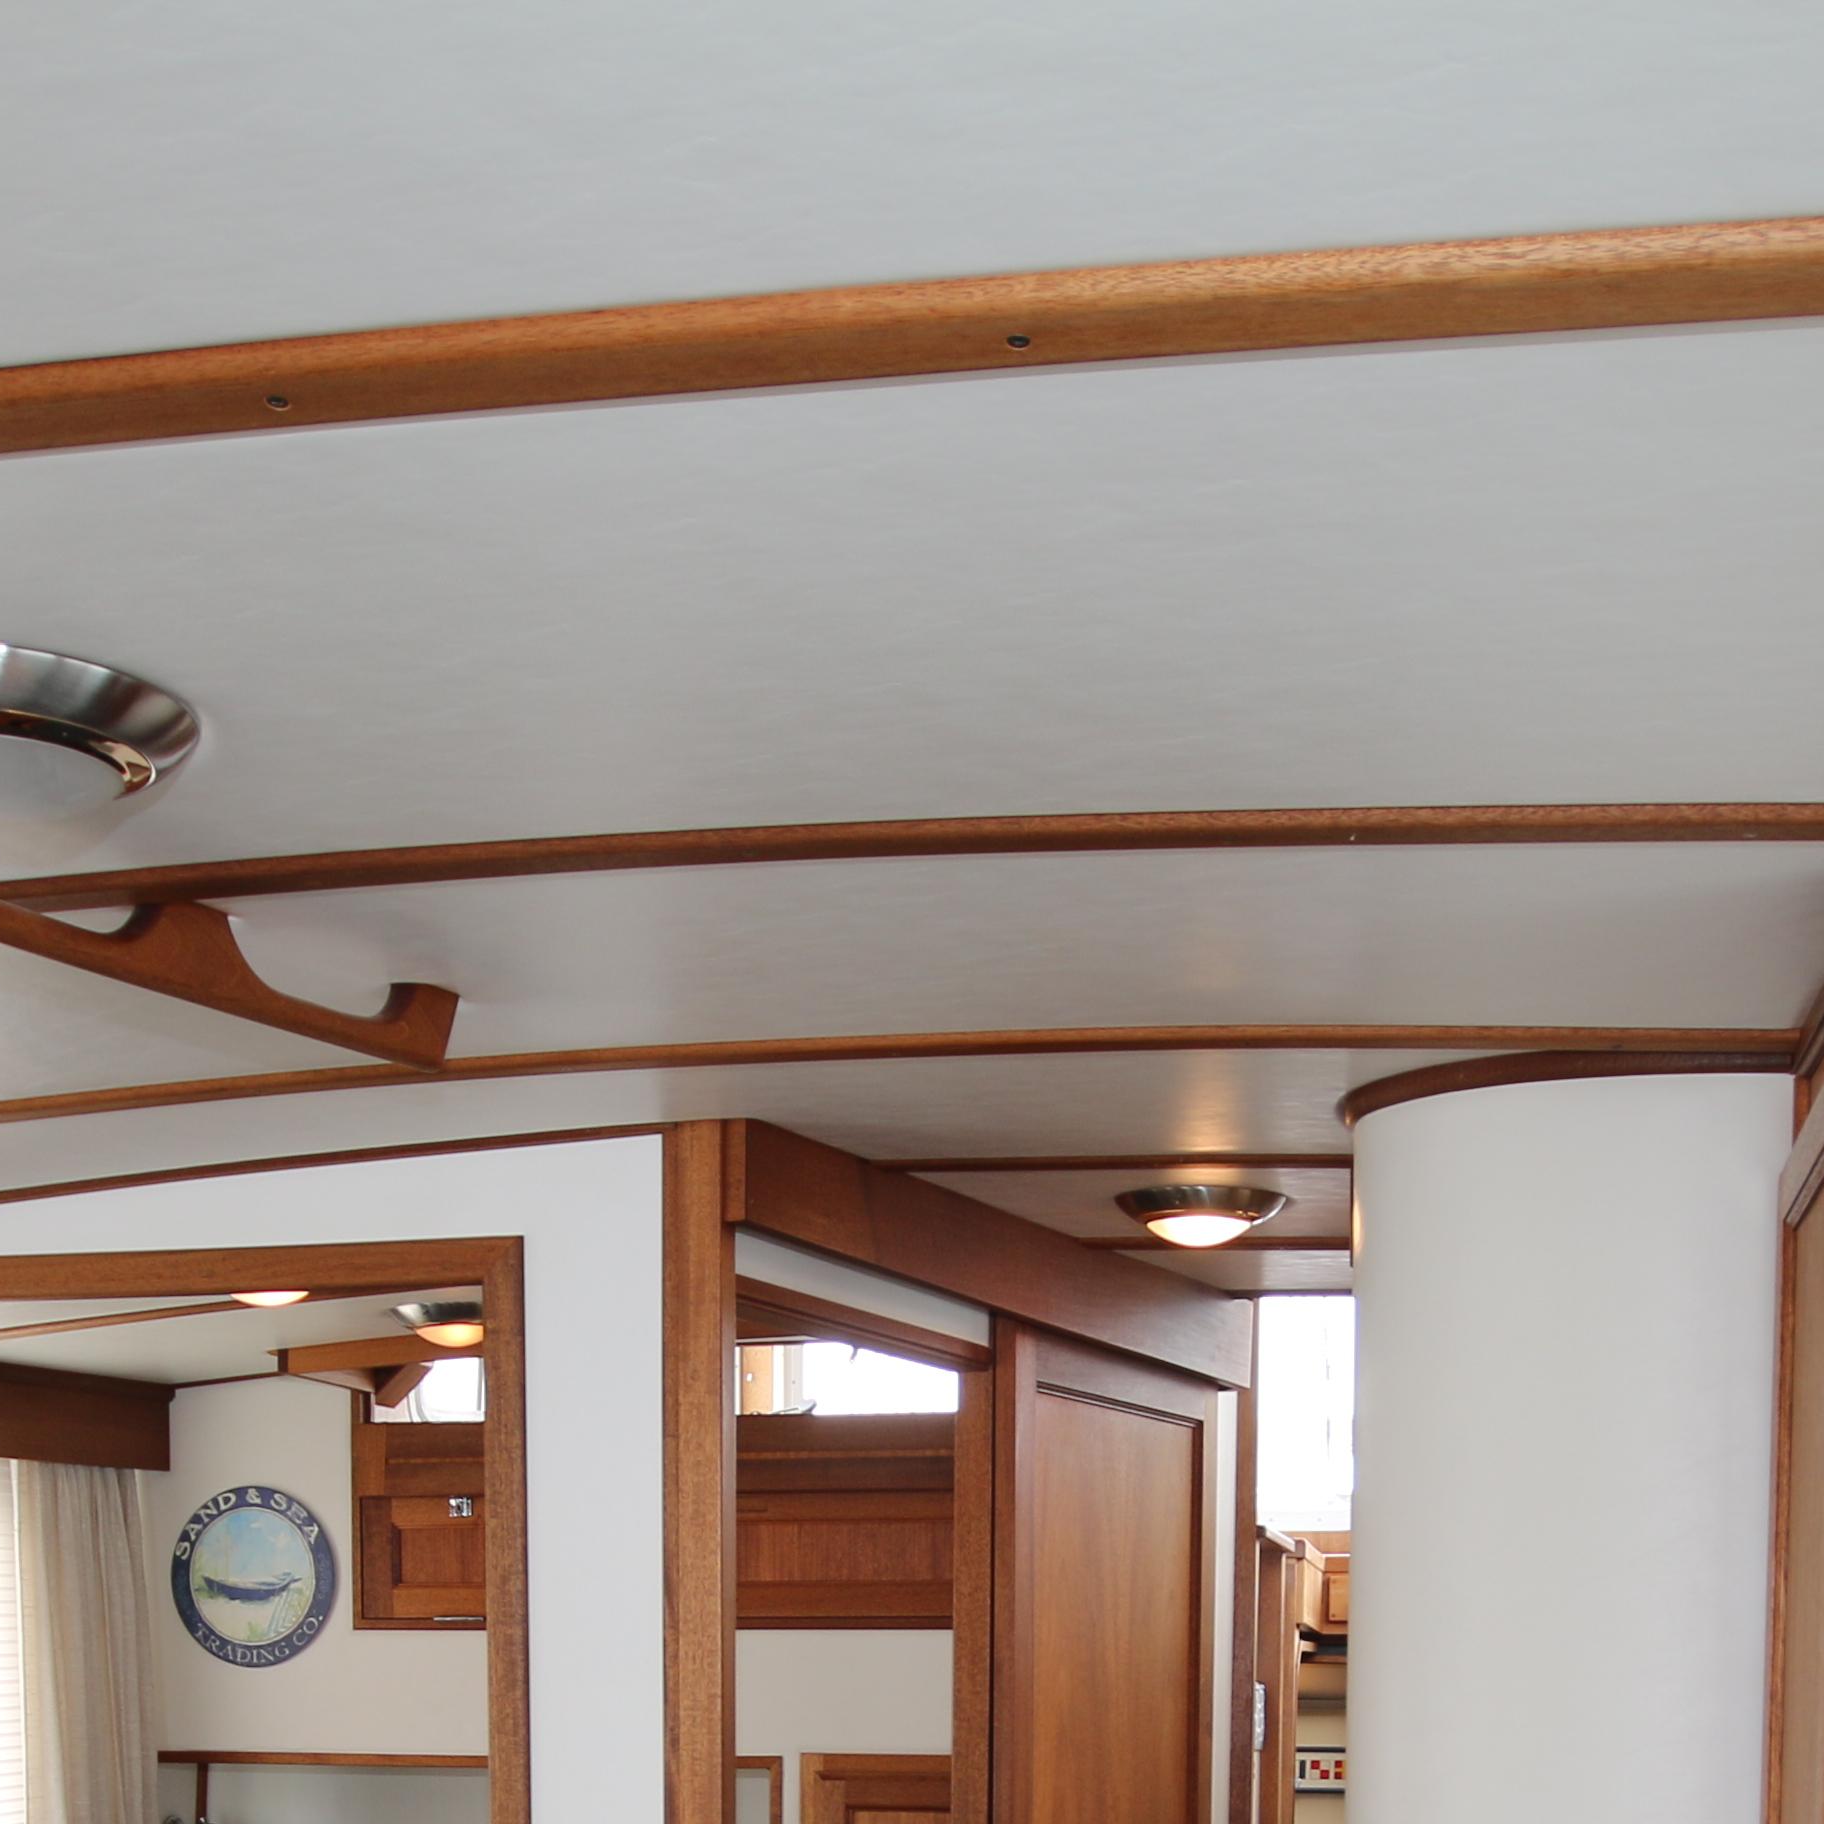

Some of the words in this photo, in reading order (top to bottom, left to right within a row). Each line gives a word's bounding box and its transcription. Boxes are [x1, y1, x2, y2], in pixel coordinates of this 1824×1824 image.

[175, 1491, 237, 1561] SAND
[245, 1487, 263, 1505] &
[269, 1492, 320, 1546] SEA
[194, 1622, 290, 1665] TRADING
[292, 1615, 324, 1646] CO.
